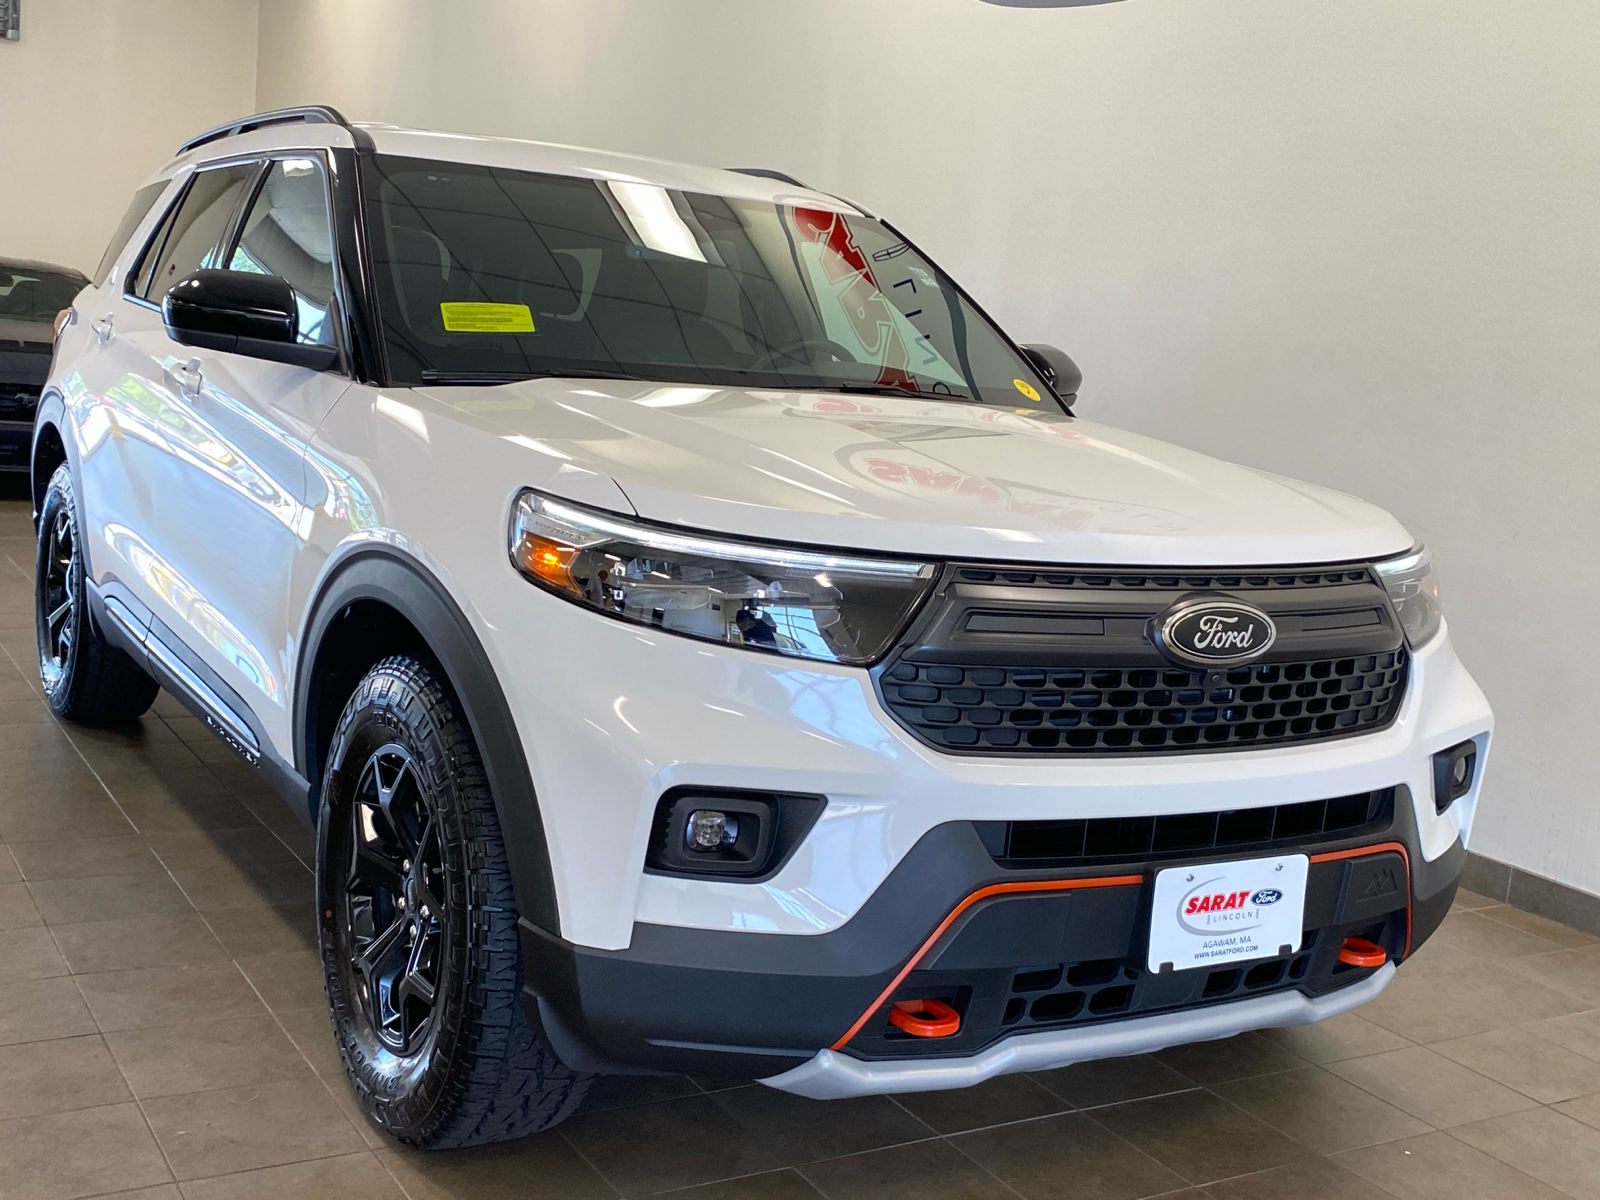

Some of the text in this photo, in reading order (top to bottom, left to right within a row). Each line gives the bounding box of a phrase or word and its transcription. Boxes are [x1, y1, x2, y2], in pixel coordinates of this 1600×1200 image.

[1193, 615, 1254, 649] Ford
[1184, 890, 1251, 915] SARAT
[1213, 912, 1253, 922] LINCOLN
[1202, 936, 1251, 949] AGAWAM, MA
[1194, 945, 1258, 959] WWW.SARATFORD.COM
